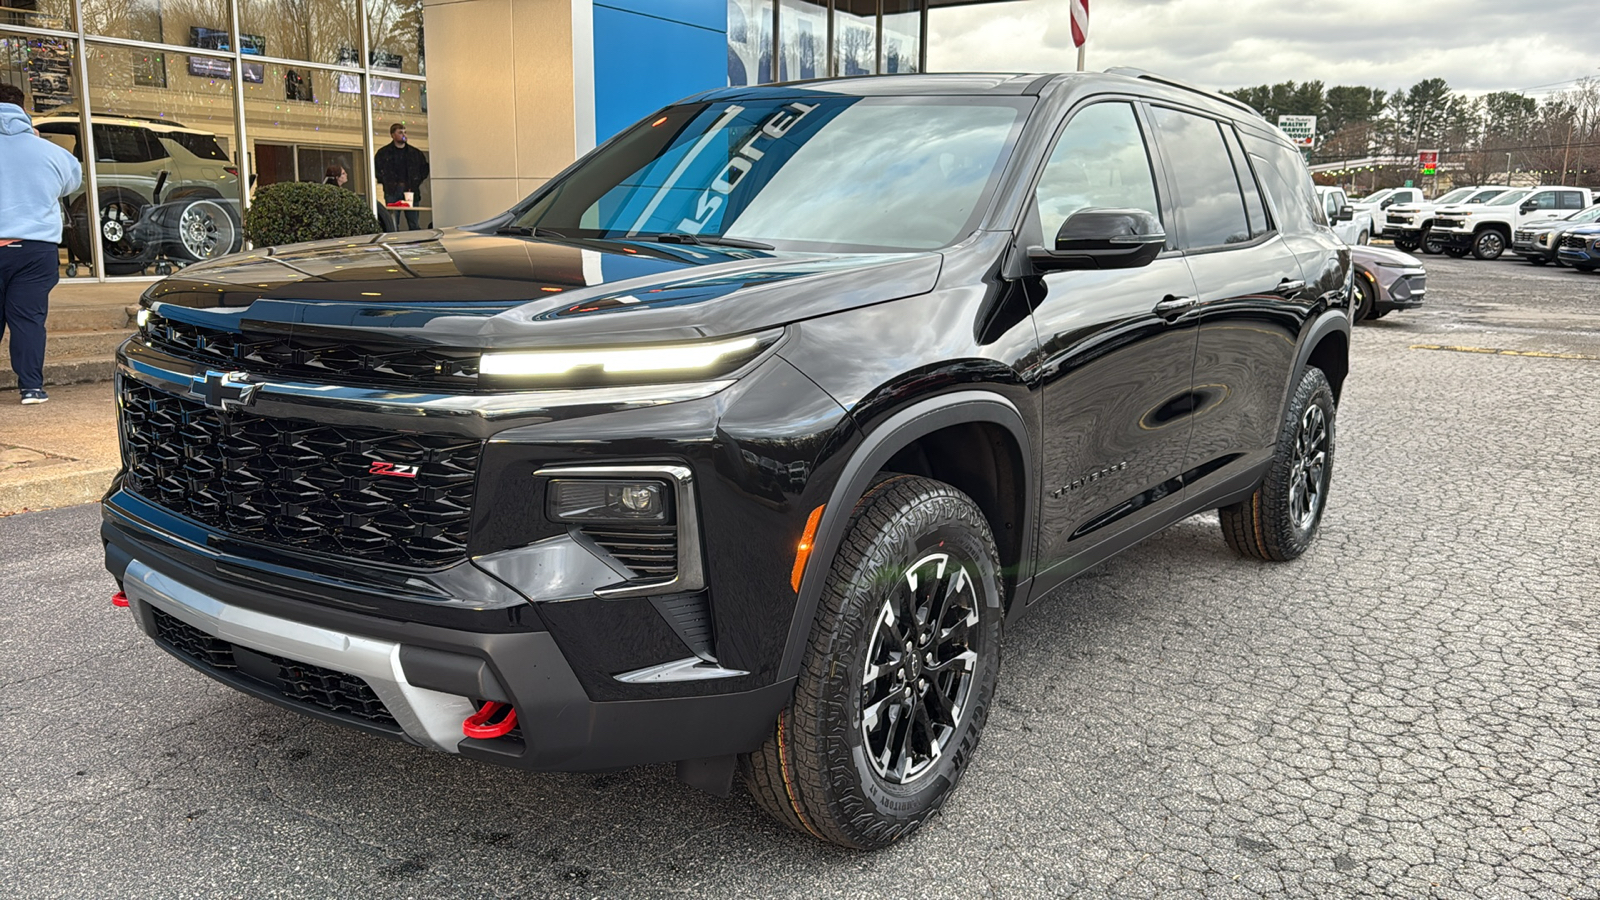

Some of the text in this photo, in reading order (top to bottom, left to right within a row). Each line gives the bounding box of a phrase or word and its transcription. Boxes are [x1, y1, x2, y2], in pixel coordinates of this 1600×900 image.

[369, 461, 419, 479] Z71
[1054, 461, 1127, 499] TRAVERSE
[952, 620, 1000, 772] WRANGLER
